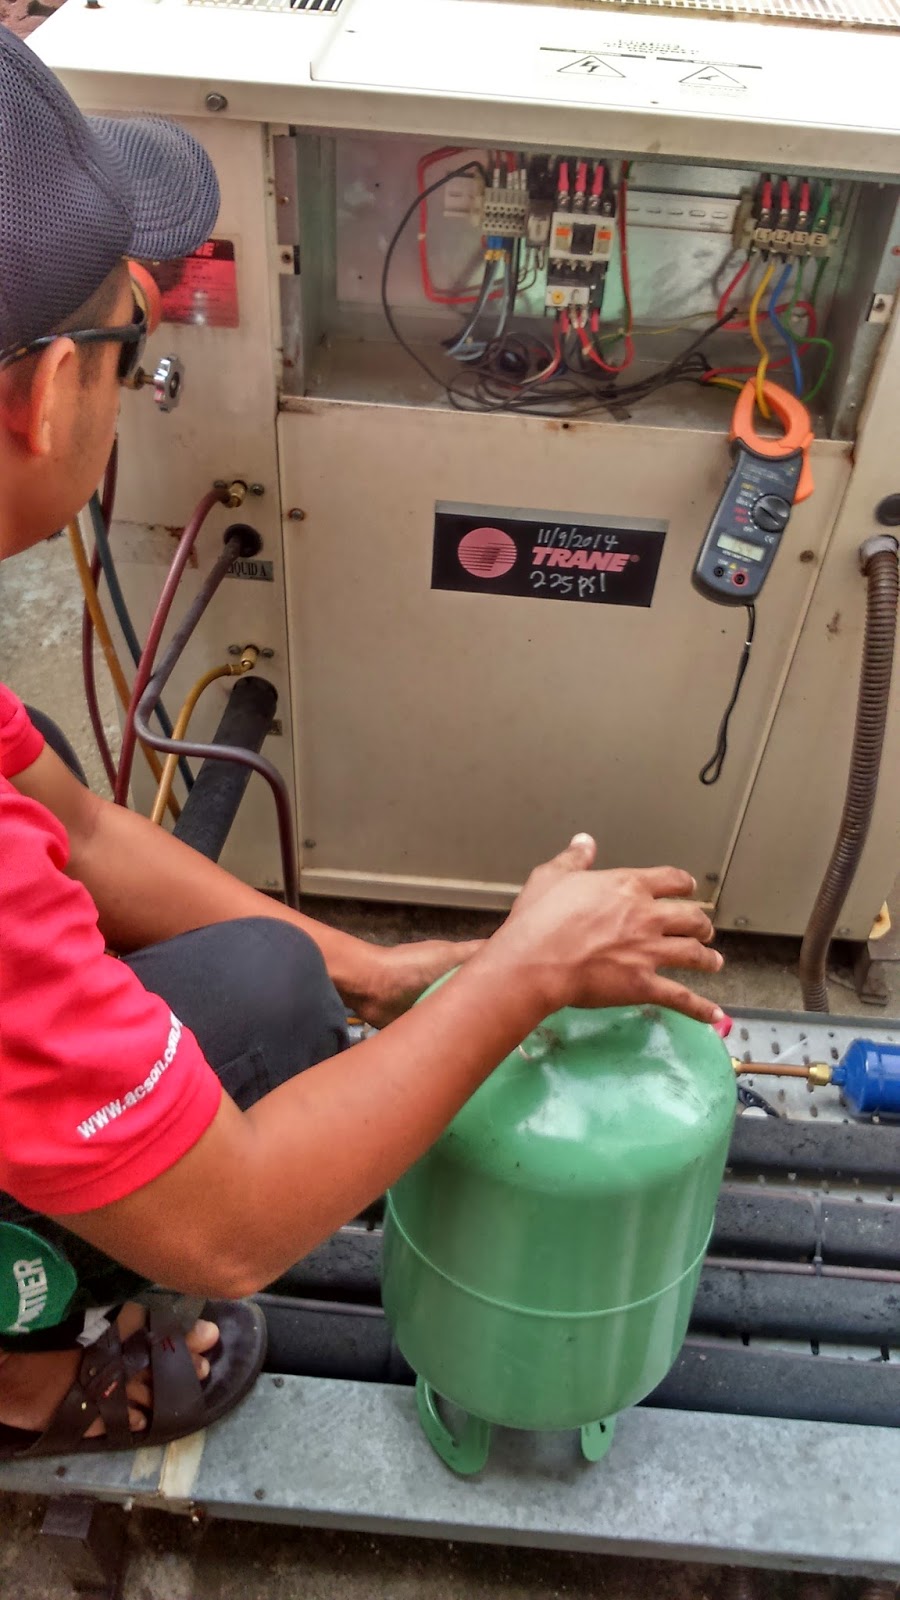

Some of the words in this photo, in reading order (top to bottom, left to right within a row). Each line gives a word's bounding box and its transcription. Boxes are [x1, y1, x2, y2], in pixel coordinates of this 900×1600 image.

[260, 563, 268, 577] A
[531, 546, 630, 573] TRANE
[529, 570, 573, 594] 225
